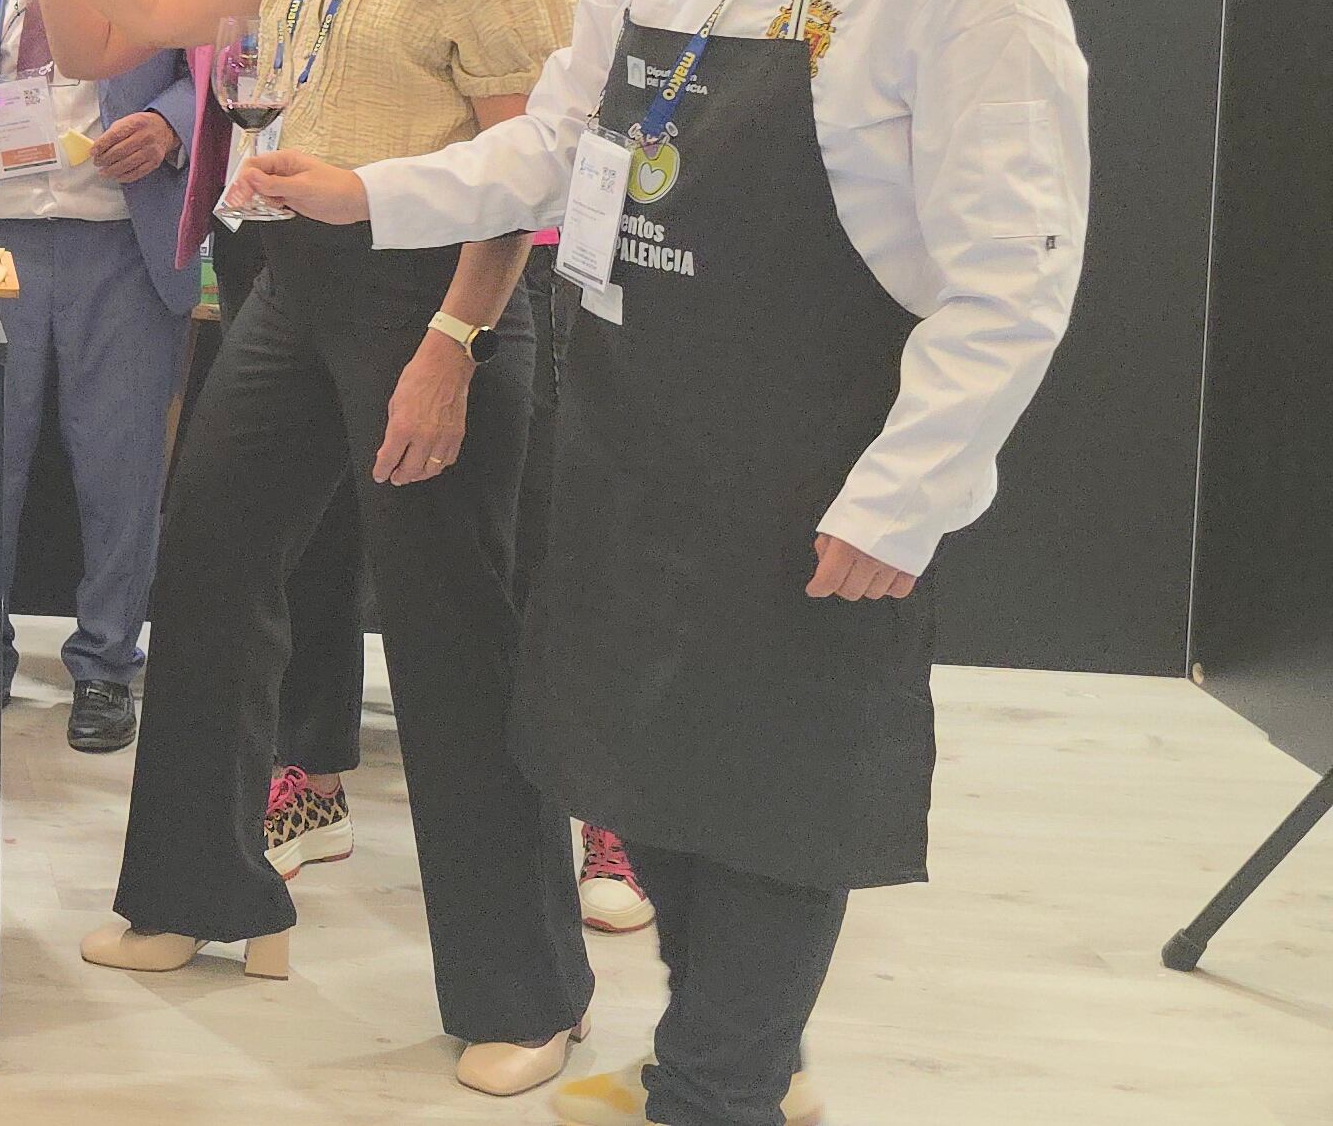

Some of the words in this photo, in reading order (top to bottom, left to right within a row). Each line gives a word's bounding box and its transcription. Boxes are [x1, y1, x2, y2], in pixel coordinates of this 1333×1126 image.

[312, 13, 333, 56] makro
[662, 51, 697, 101] makro
[620, 213, 665, 243] entos
